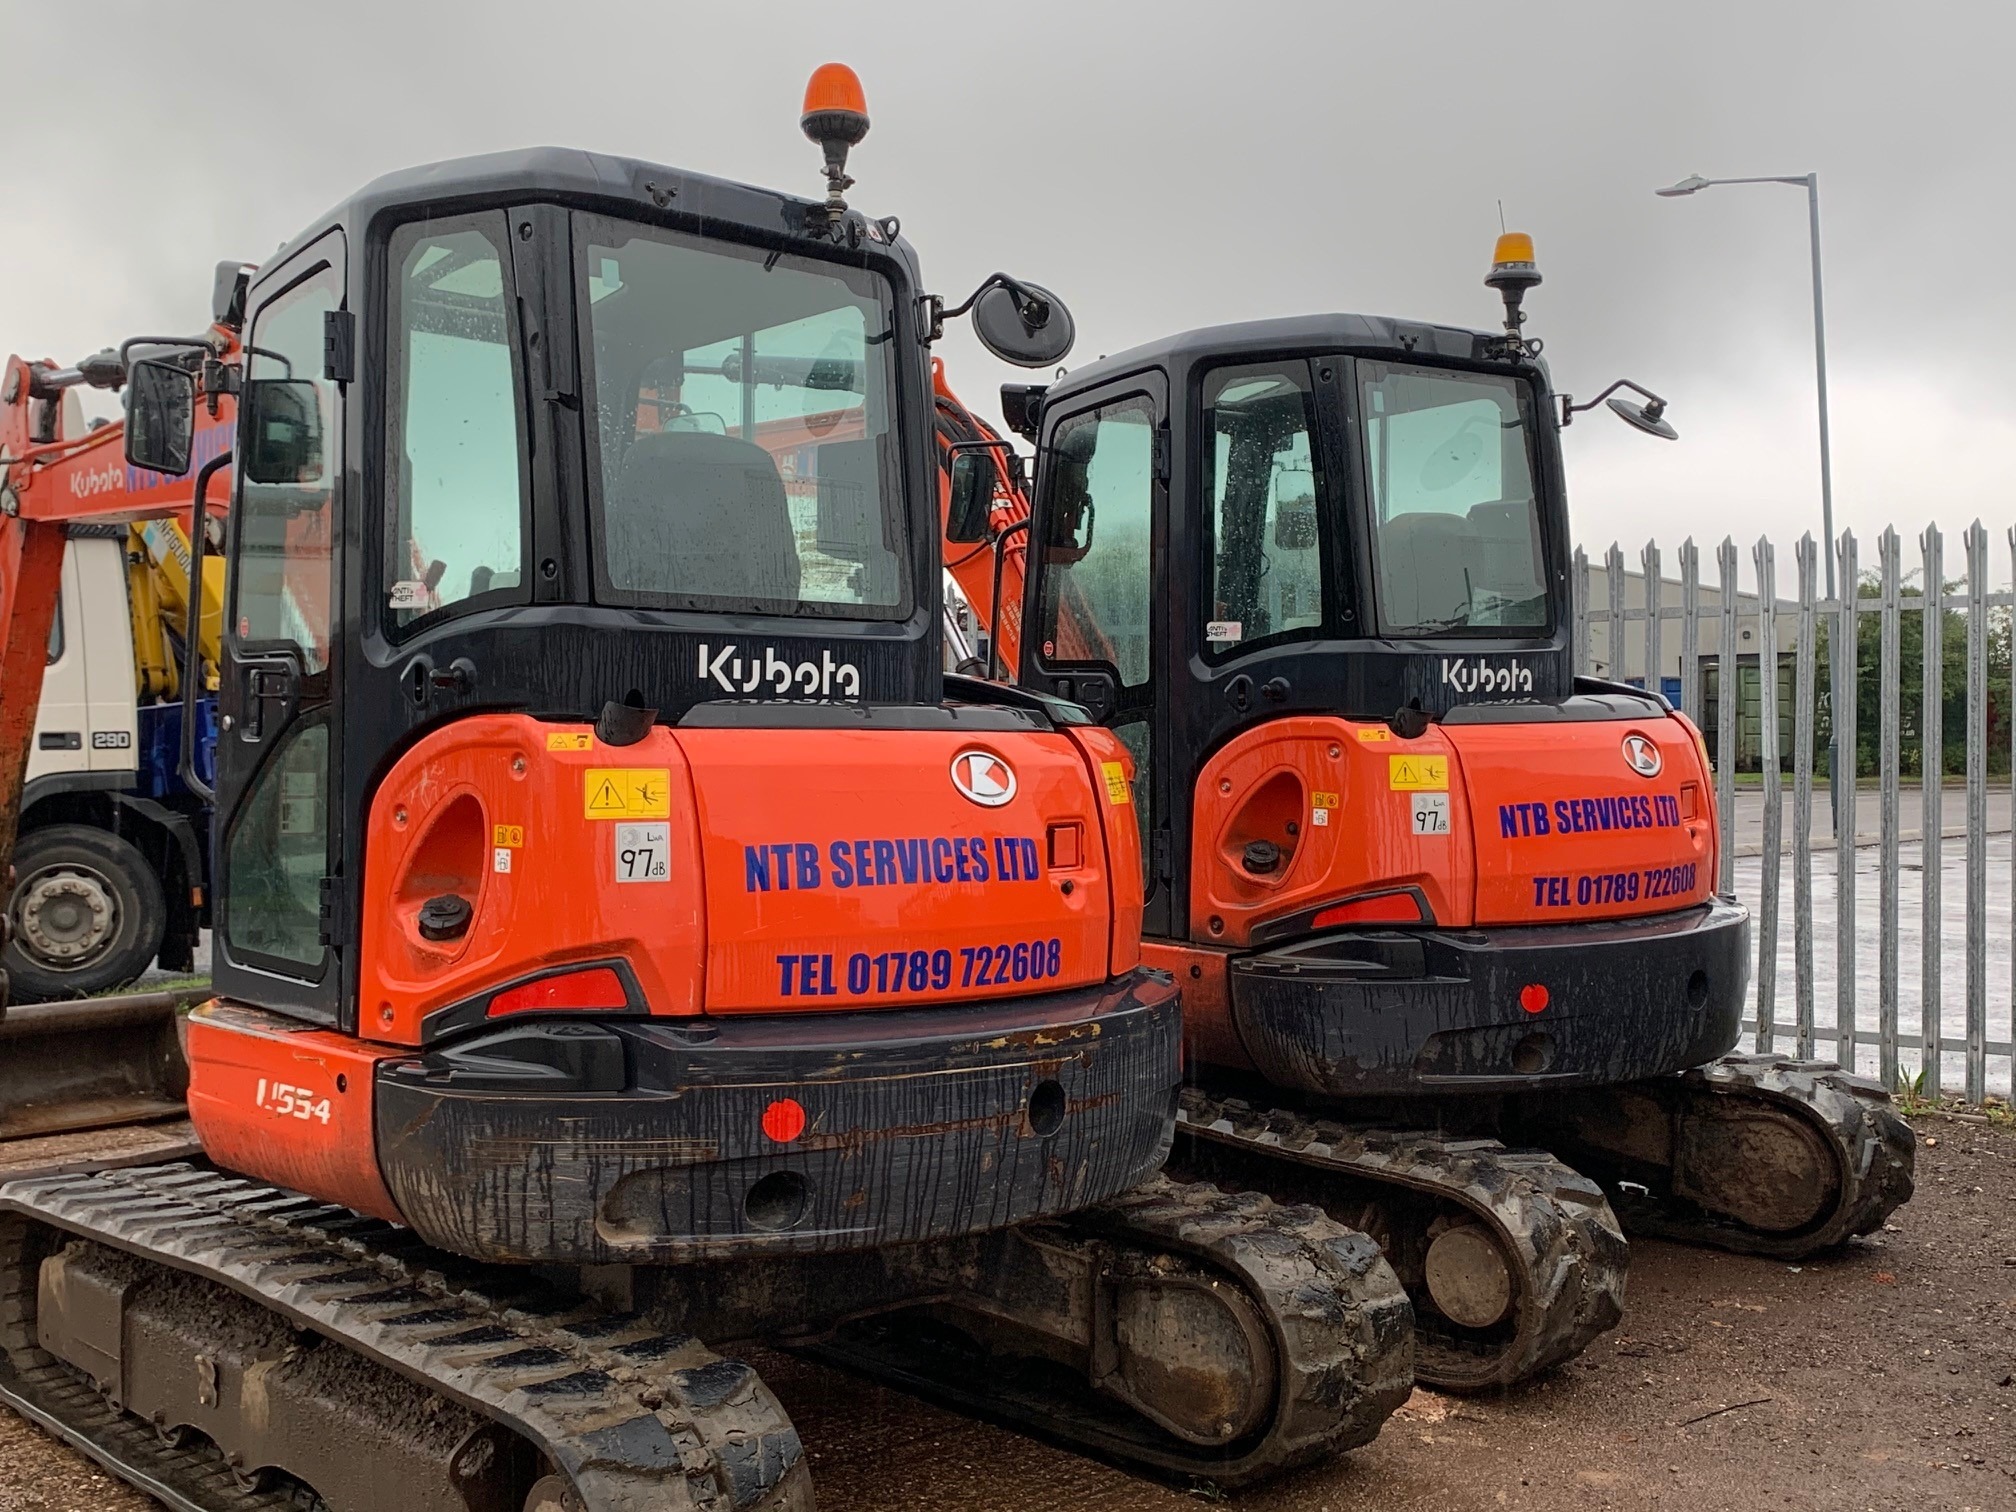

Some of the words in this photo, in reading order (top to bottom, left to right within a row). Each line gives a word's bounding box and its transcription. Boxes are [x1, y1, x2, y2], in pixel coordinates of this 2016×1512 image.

[70, 462, 124, 499] Kubota
[698, 643, 861, 697] Kubota
[1442, 658, 1533, 693] Kubota
[94, 732, 130, 748] 290
[1416, 811, 1439, 832] 97
[1499, 802, 1550, 839] NTB
[1554, 795, 1652, 834] SERVICES
[1653, 795, 1680, 827] LTD
[620, 848, 654, 878] 97
[651, 861, 666, 876] dB
[744, 843, 821, 893] NTB
[829, 837, 990, 888] SERVICES
[994, 837, 1040, 882] LTD
[1533, 876, 1572, 907] TEL
[1576, 872, 1639, 906] 01789
[1643, 862, 1697, 899] 722608
[776, 954, 838, 996] TEL
[847, 949, 952, 995] 01789
[960, 938, 1062, 988] 722608
